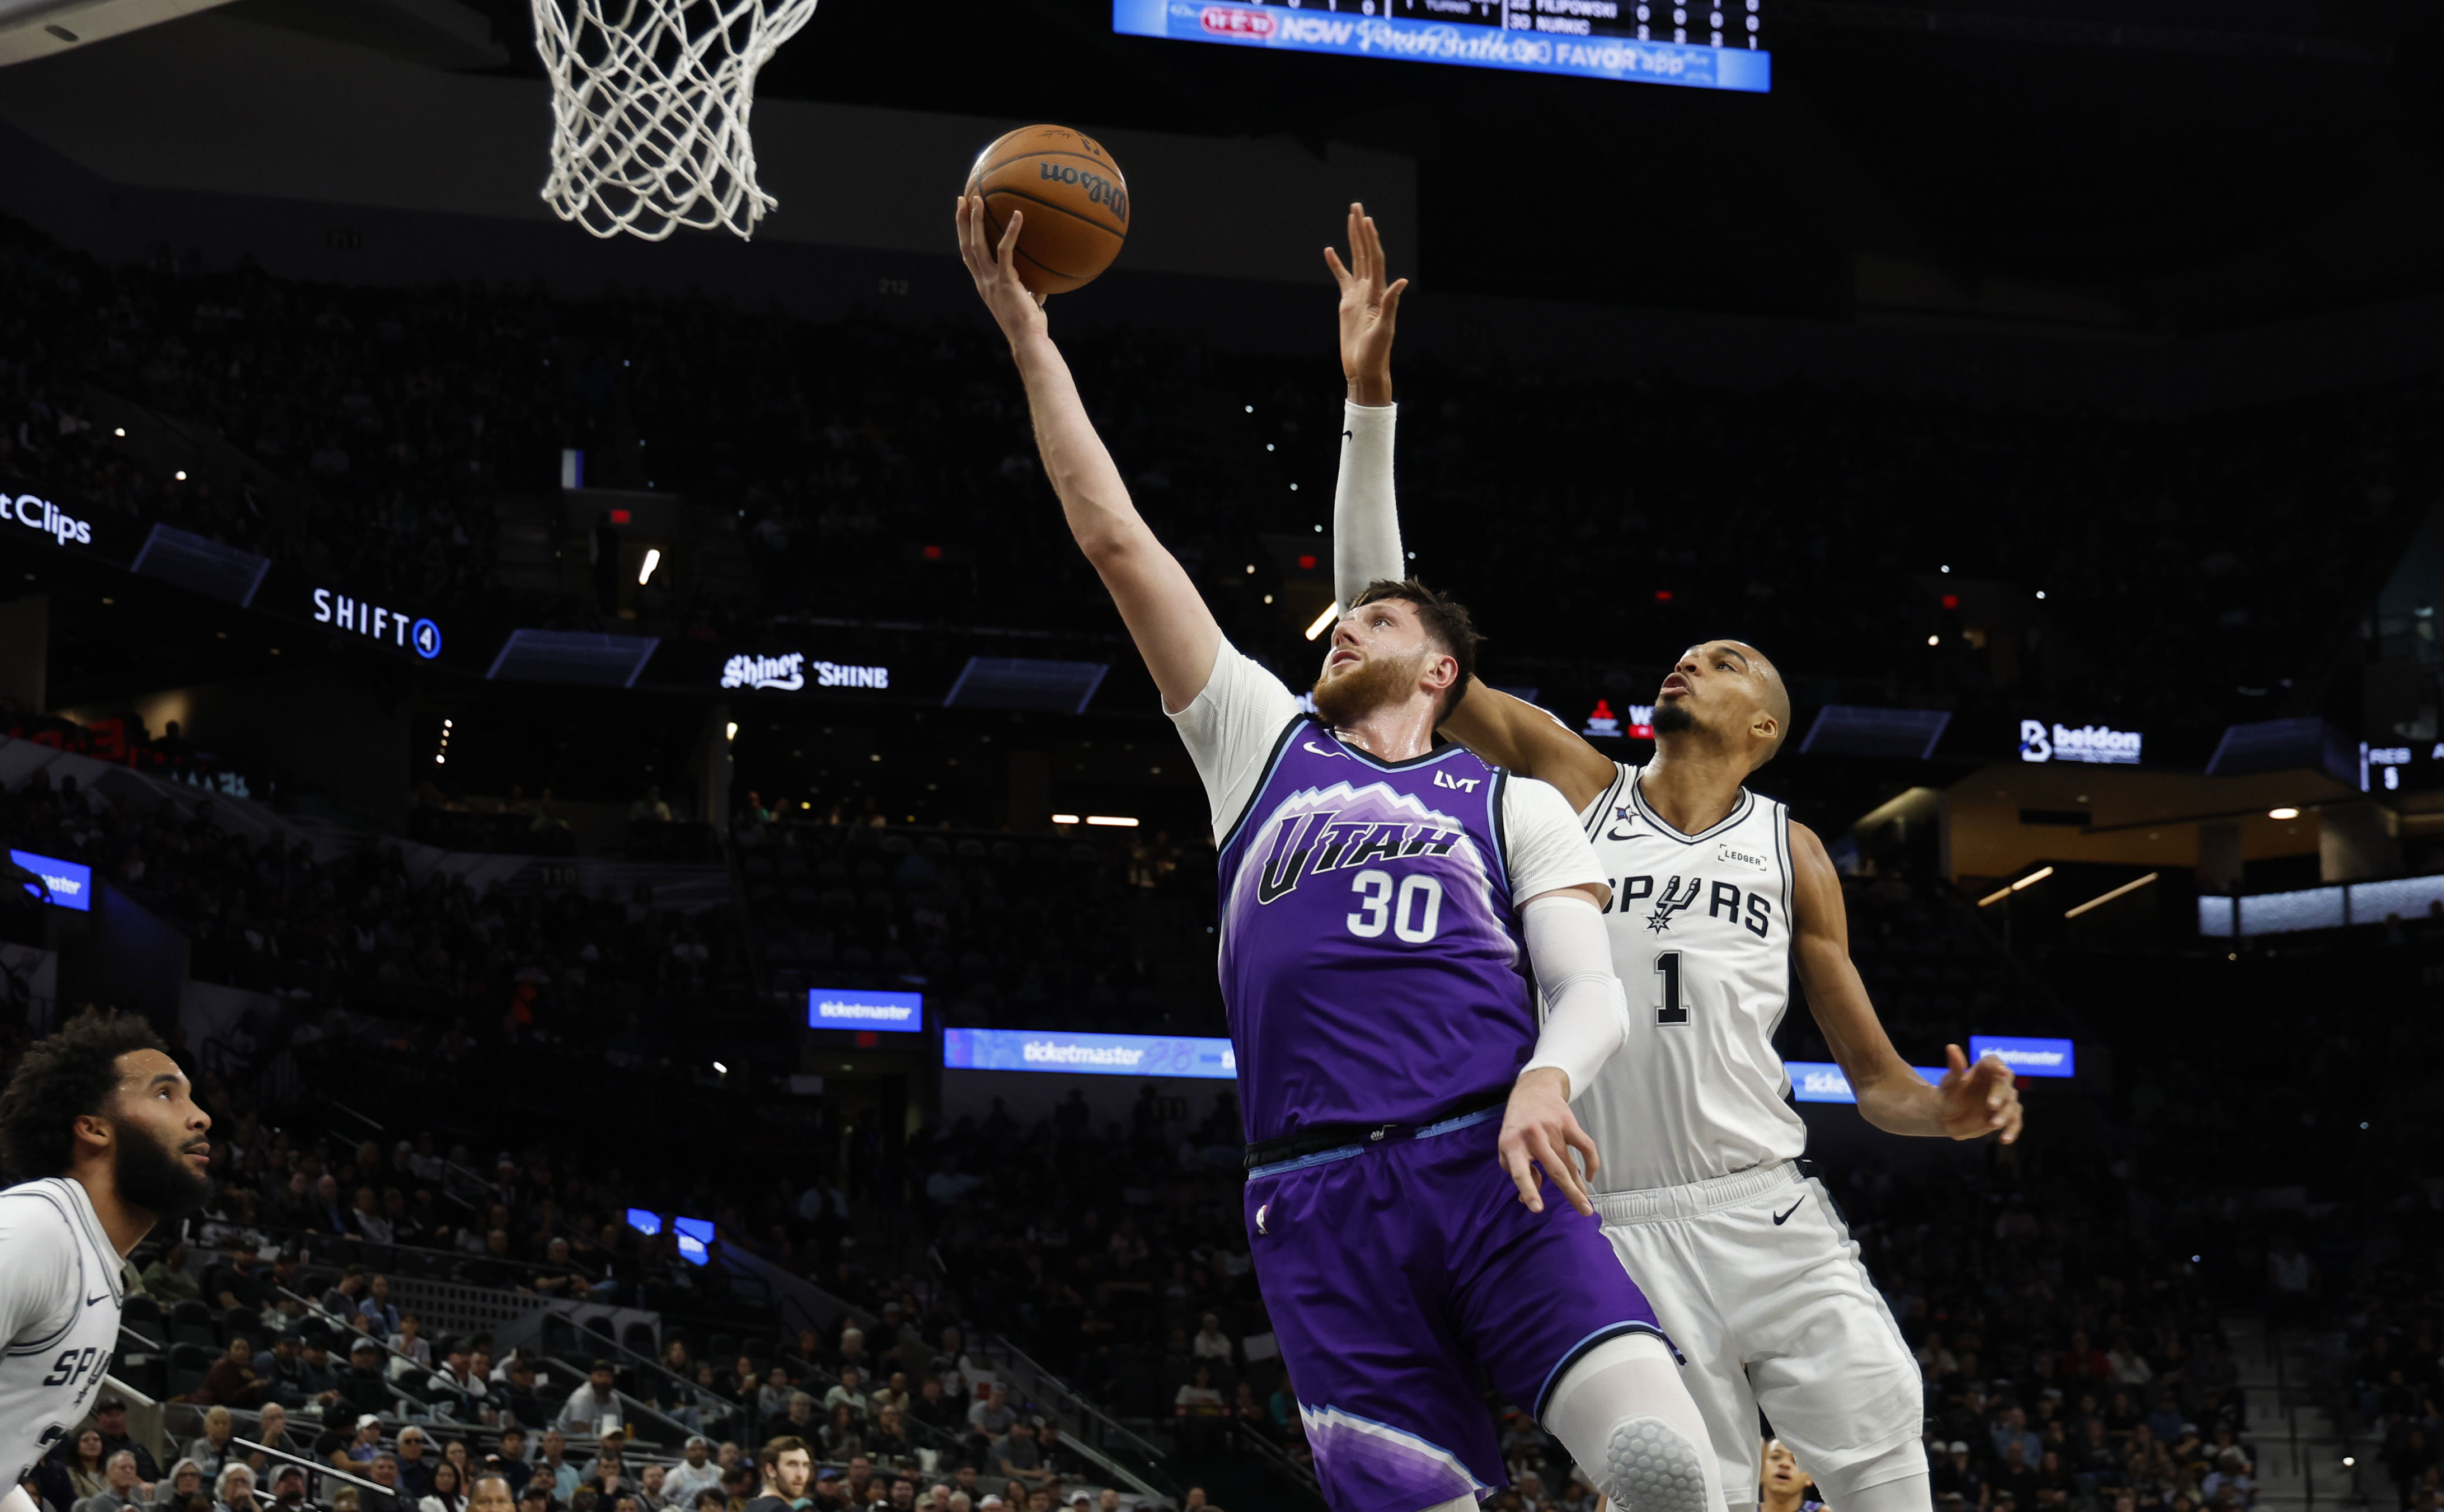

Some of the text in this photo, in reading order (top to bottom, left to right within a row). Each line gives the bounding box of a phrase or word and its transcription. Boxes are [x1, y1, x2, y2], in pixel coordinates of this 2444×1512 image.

[1282, 16, 1353, 45] NOW
[1556, 43, 1637, 71] FAVOR
[1039, 161, 1127, 223] Wilson
[878, 278, 909, 296] 212
[16, 494, 92, 546] Clips
[1433, 769, 1481, 793] LVT
[1257, 810, 1470, 905] UTAH
[1725, 850, 1761, 866] LEDGER
[1346, 868, 1443, 944] 30
[1653, 949, 1690, 1027] 1
[820, 1001, 912, 1021] ticketmaster
[1024, 1041, 1144, 1065] ticketmaster
